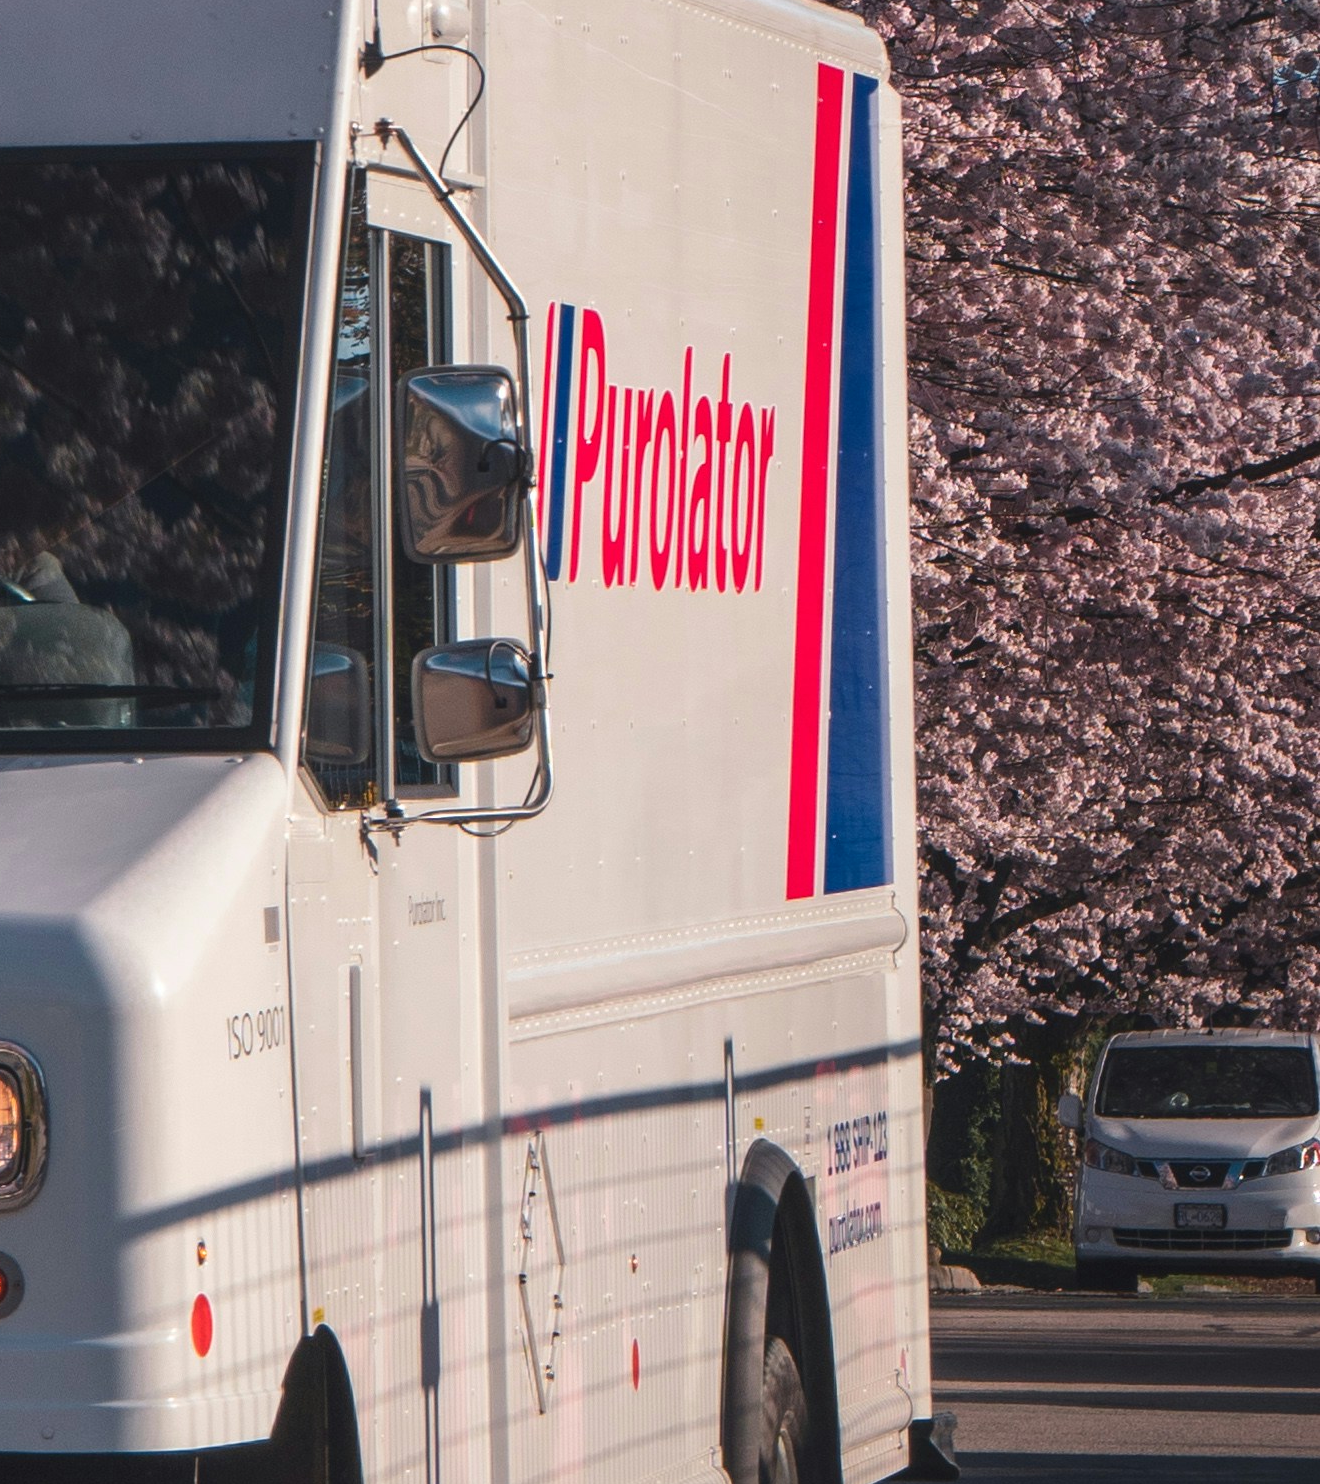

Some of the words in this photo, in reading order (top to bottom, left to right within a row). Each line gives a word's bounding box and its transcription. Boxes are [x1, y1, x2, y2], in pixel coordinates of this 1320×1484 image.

[568, 308, 777, 595] Purolator
[226, 1012, 254, 1061] ISO
[256, 1005, 286, 1053] 9001
